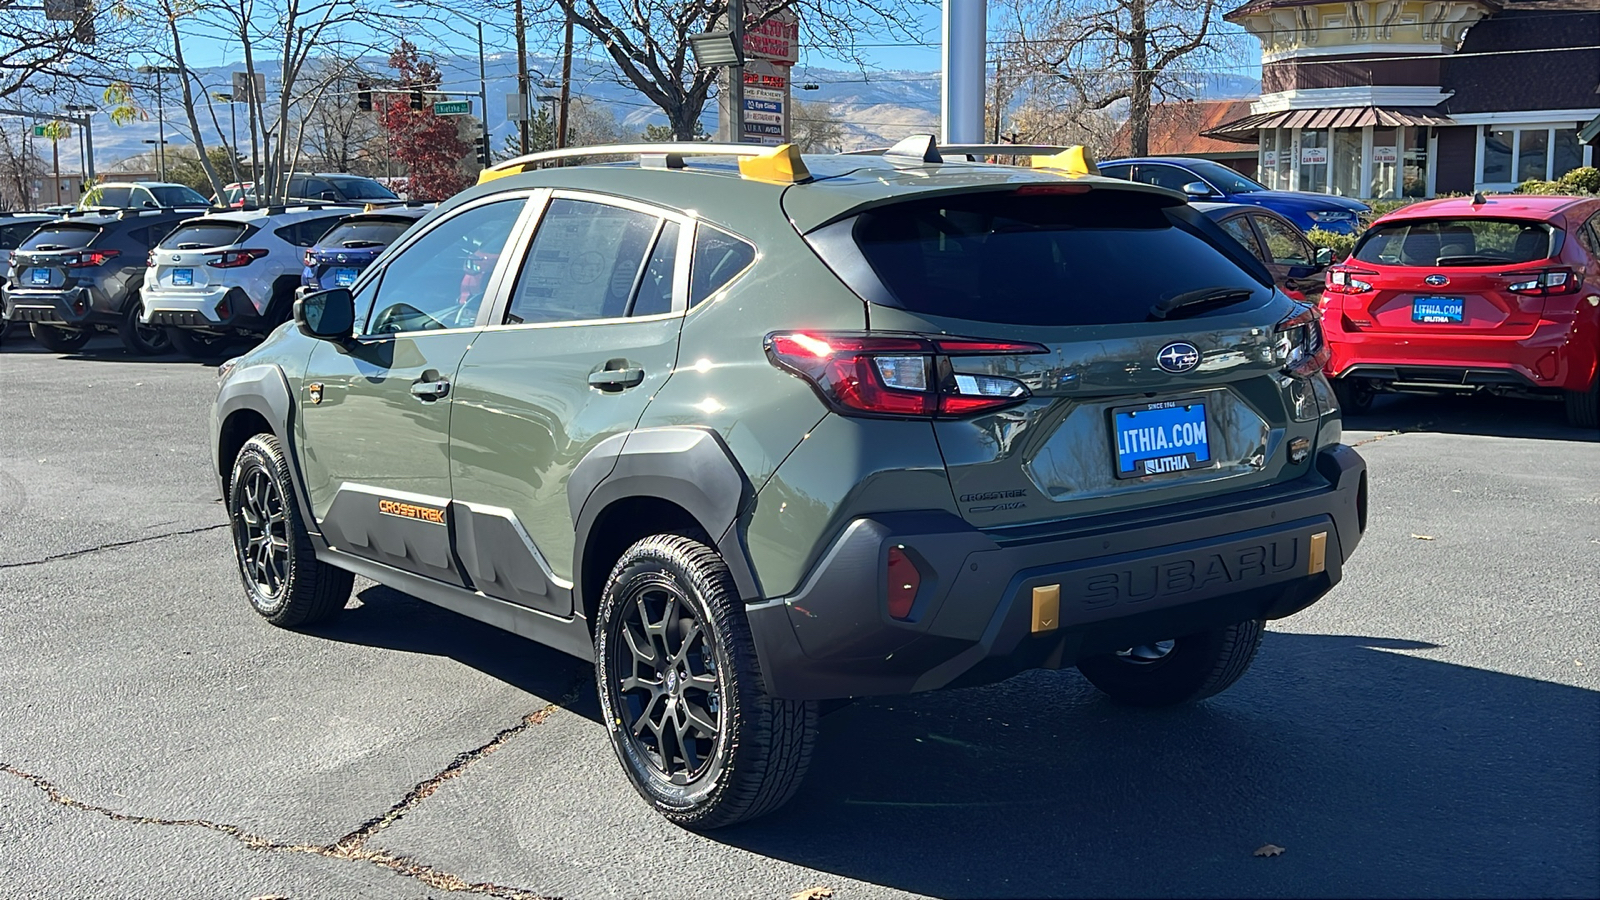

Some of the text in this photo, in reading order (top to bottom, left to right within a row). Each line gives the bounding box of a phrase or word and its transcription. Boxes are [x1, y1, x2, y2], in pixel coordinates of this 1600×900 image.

[1414, 305, 1462, 314] LITHIA.COM
[1147, 402, 1163, 410] SINCE
[1117, 421, 1207, 455] LITHIA.COM
[1155, 455, 1190, 473] LITHIA
[960, 489, 1027, 502] CROSSTREK
[379, 499, 445, 523] CROSSTREK
[1084, 538, 1298, 611] SUBARU
